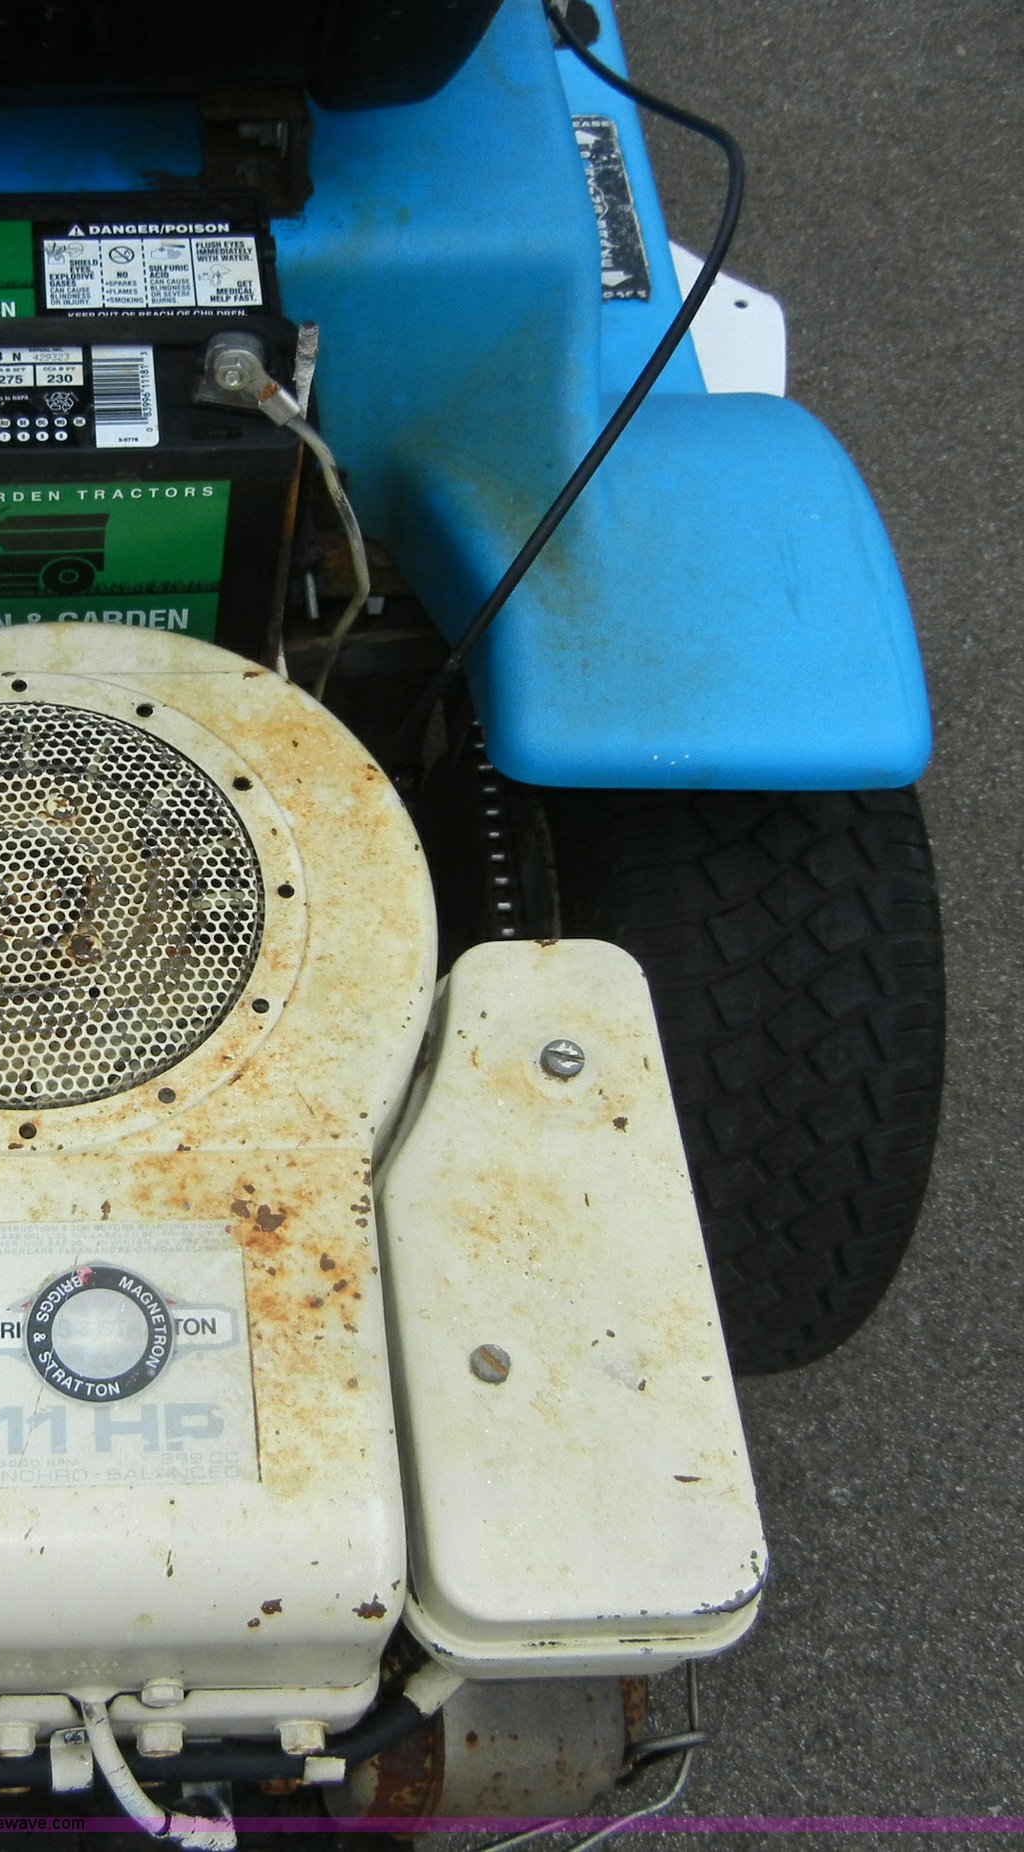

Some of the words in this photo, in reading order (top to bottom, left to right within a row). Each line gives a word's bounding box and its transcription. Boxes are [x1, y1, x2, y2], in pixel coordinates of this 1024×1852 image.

[88, 223, 230, 236] DANGER/POISON
[196, 241, 222, 249] FLUSH
[224, 241, 245, 249] EYES
[197, 248, 253, 256] IMMEDIATELY
[69, 259, 98, 267] SHIELD
[148, 264, 190, 273] SULFURIC
[49, 272, 95, 281] EXPLOSIVE
[116, 271, 129, 279] NO
[149, 271, 170, 279] ACID
[236, 280, 253, 288] GET
[216, 287, 254, 295] MEDICAL
[12, 352, 22, 361] N
[46, 374, 73, 384] 230
[140, 364, 149, 388] 11181
[142, 392, 152, 417] 83996
[76, 485, 215, 501] TRACTORS
[57, 608, 189, 630] GARDEN
[35, 1274, 84, 1323] BRIGGS
[32, 1331, 47, 1344] &
[38, 1350, 121, 1397] STRATTON
[93, 1402, 226, 1453] HP
[46, 1457, 79, 1467] RPM
[106, 1464, 241, 1482] BALANCED
